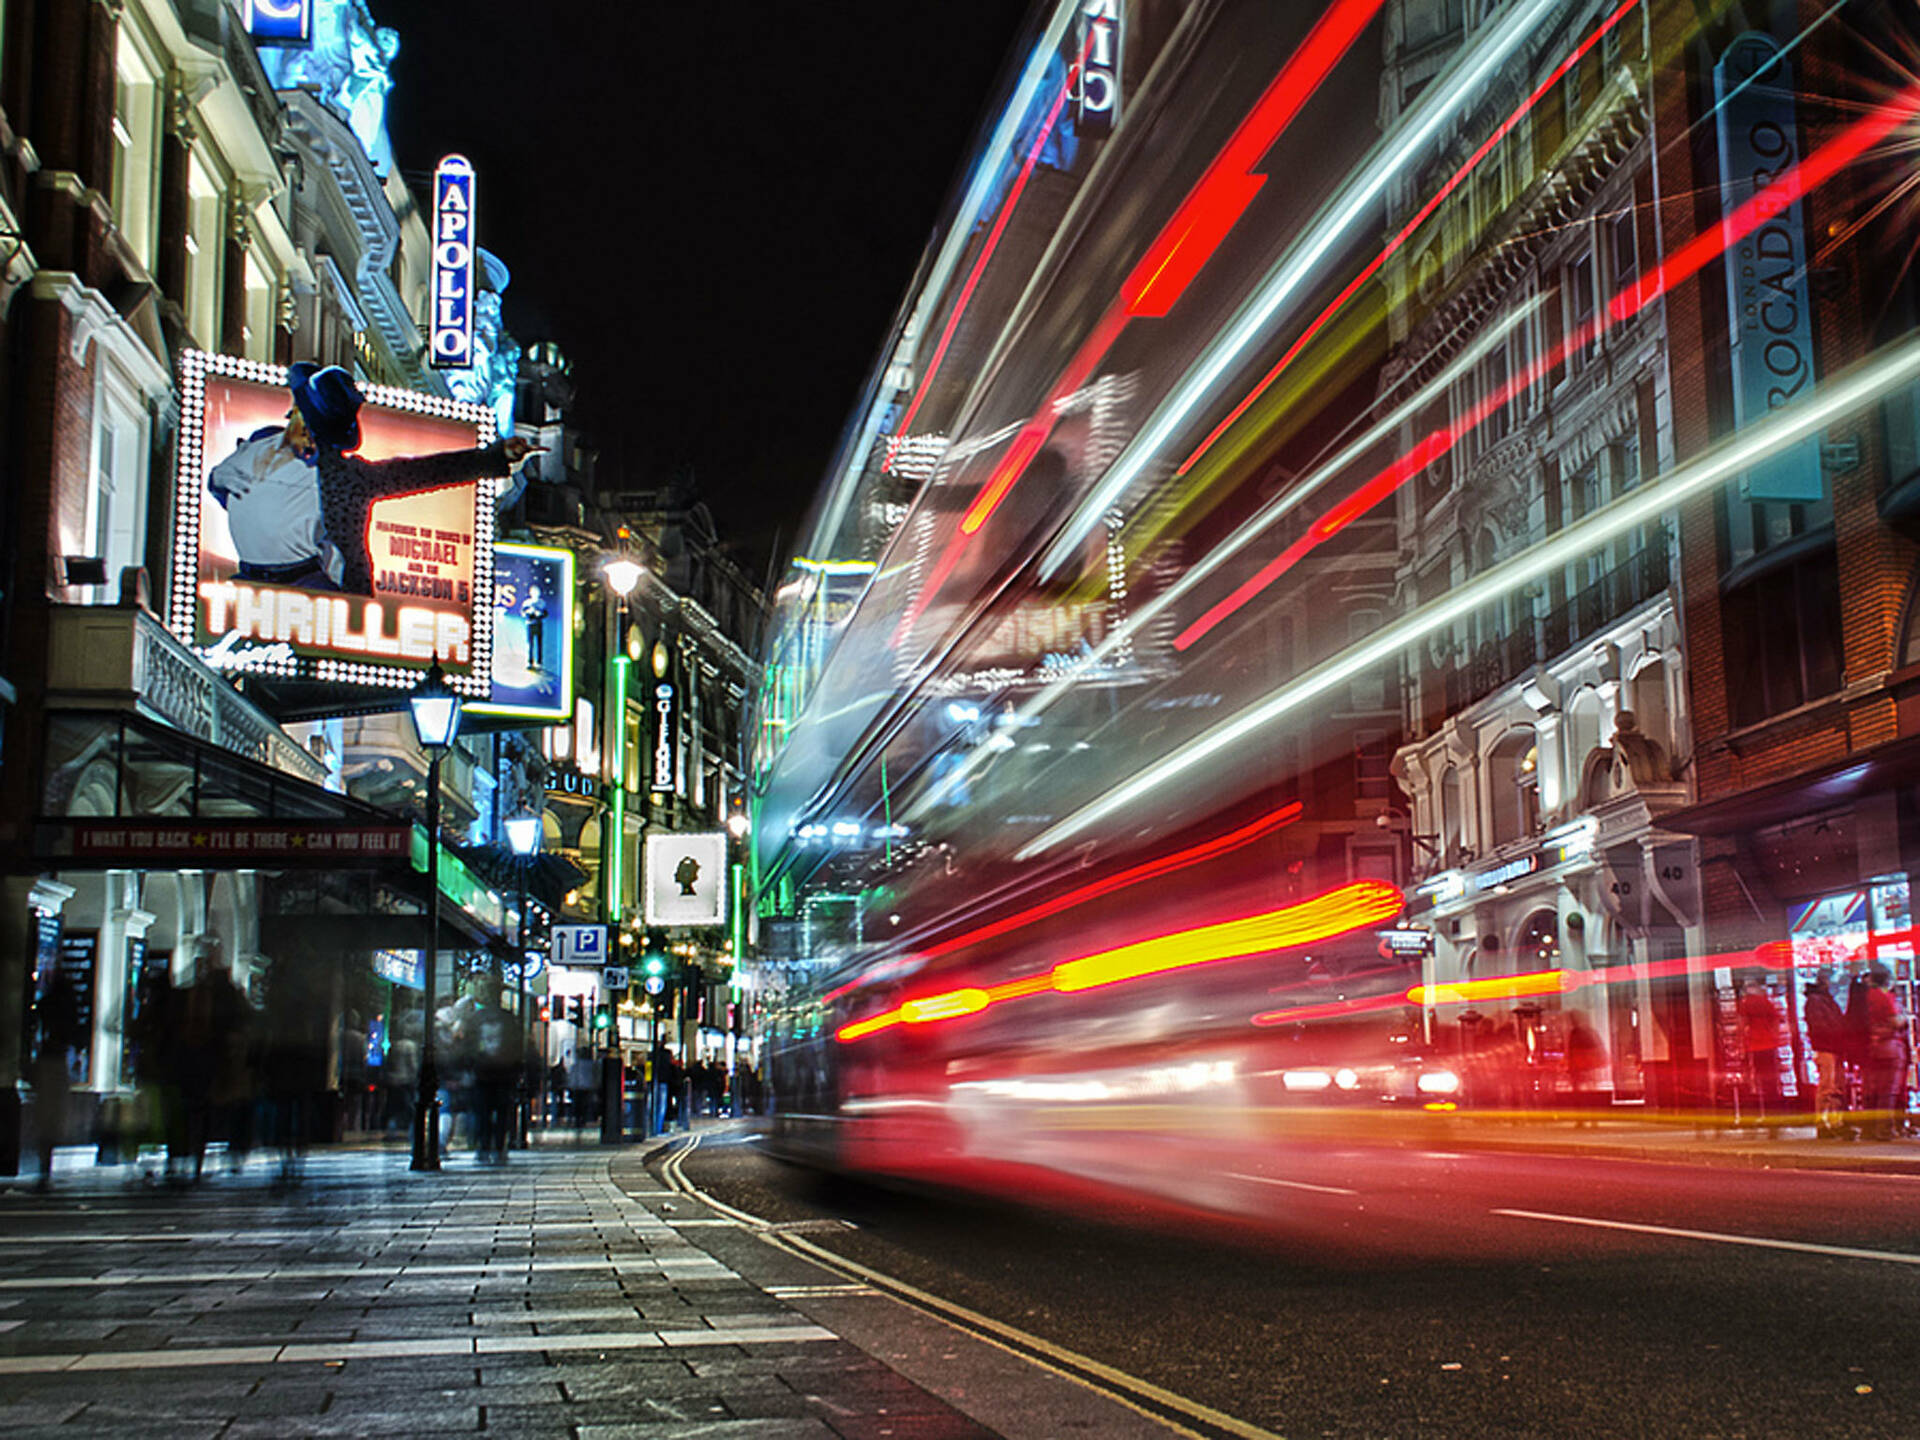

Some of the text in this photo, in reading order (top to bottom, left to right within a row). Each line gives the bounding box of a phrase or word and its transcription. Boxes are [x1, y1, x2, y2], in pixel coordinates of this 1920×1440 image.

[435, 184, 469, 355] APOLLO
[1749, 119, 1808, 413] ROCADERO
[1741, 240, 1757, 331] LONDO
[389, 535, 458, 566] MICHAEL
[375, 570, 469, 602] JACKSON 5
[199, 582, 470, 663] THRILLER
[91, 831, 127, 847] WANT
[130, 831, 154, 847] YOU
[156, 831, 190, 848] BACK
[234, 832, 249, 848] BE
[253, 832, 288, 848] THERE
[307, 832, 332, 848] CAN
[335, 832, 359, 849] YOU
[361, 832, 385, 849] FEEL
[388, 832, 401, 849] IT
[1611, 882, 1631, 894] 40
[1662, 866, 1683, 880] 40
[579, 933, 595, 950] P
